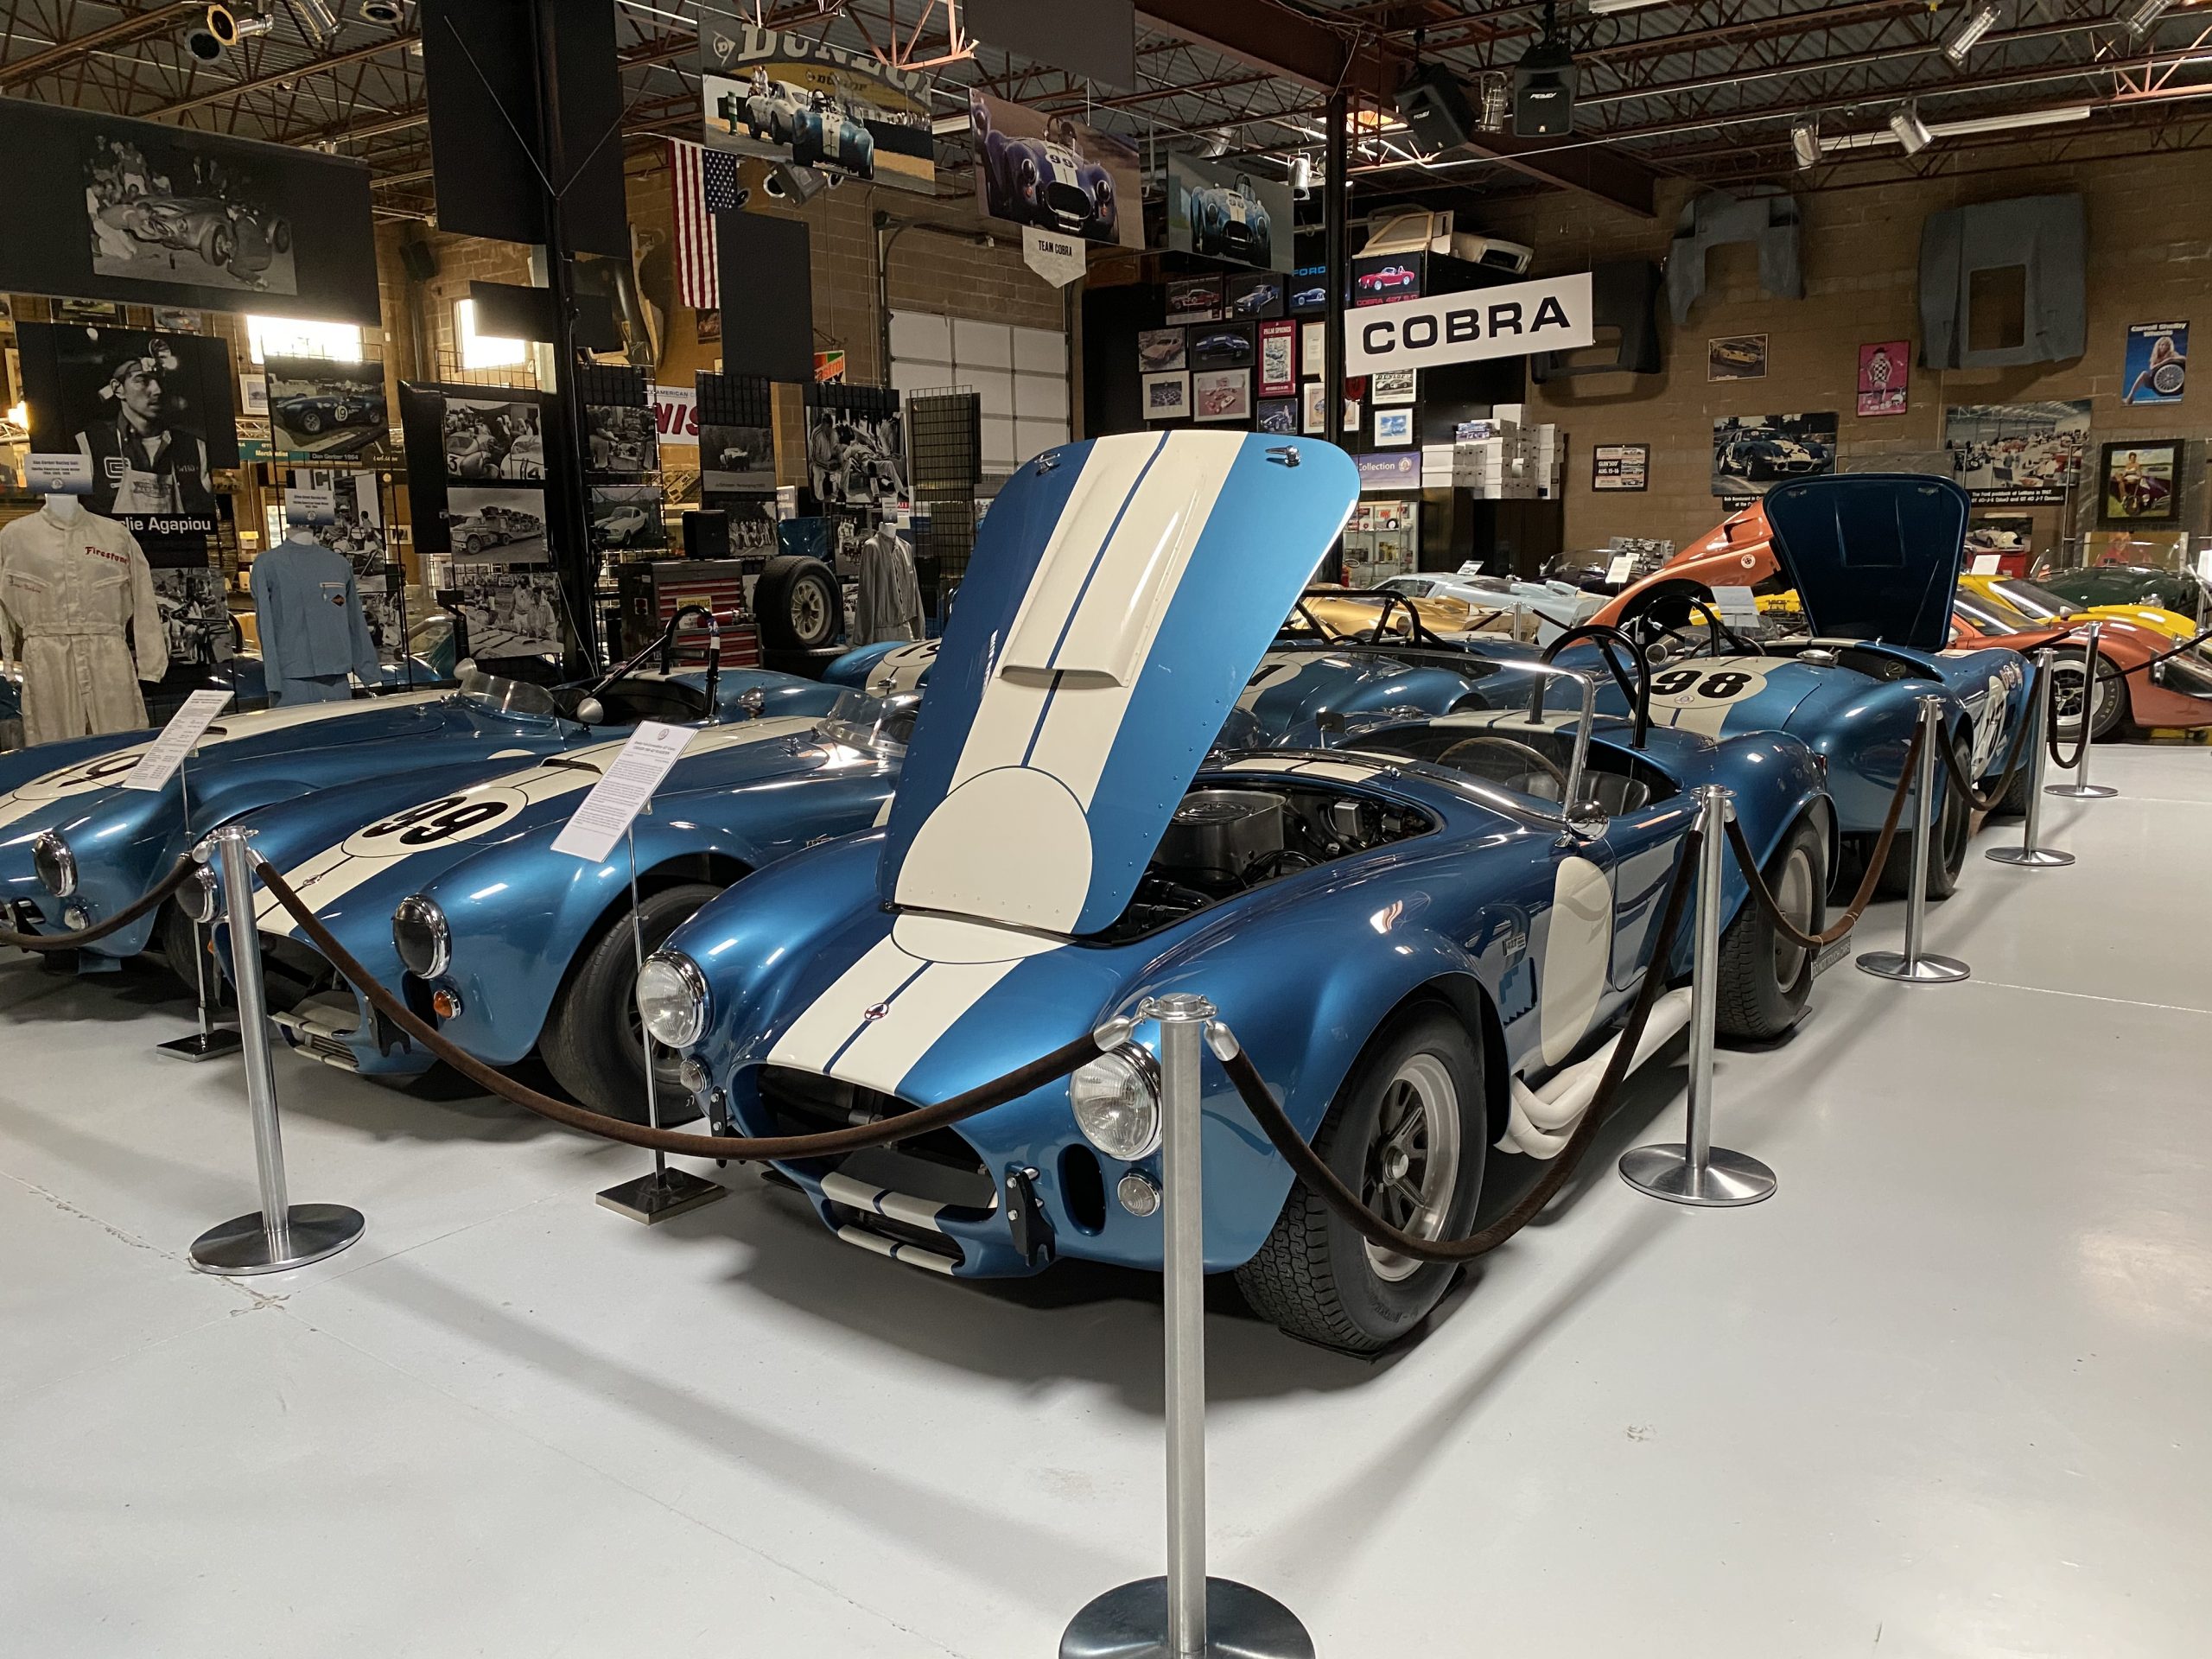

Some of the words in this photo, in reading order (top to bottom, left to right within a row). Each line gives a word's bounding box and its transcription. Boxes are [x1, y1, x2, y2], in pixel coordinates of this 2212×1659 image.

[1039, 239, 1054, 253] TEAM
[1054, 243, 1072, 257] COBRA
[1292, 265, 1326, 276] FORD
[1362, 296, 1572, 355] COBRA
[1358, 461, 1395, 472] Collection
[149, 517, 212, 534] Agapiou
[1651, 670, 1752, 699] 98
